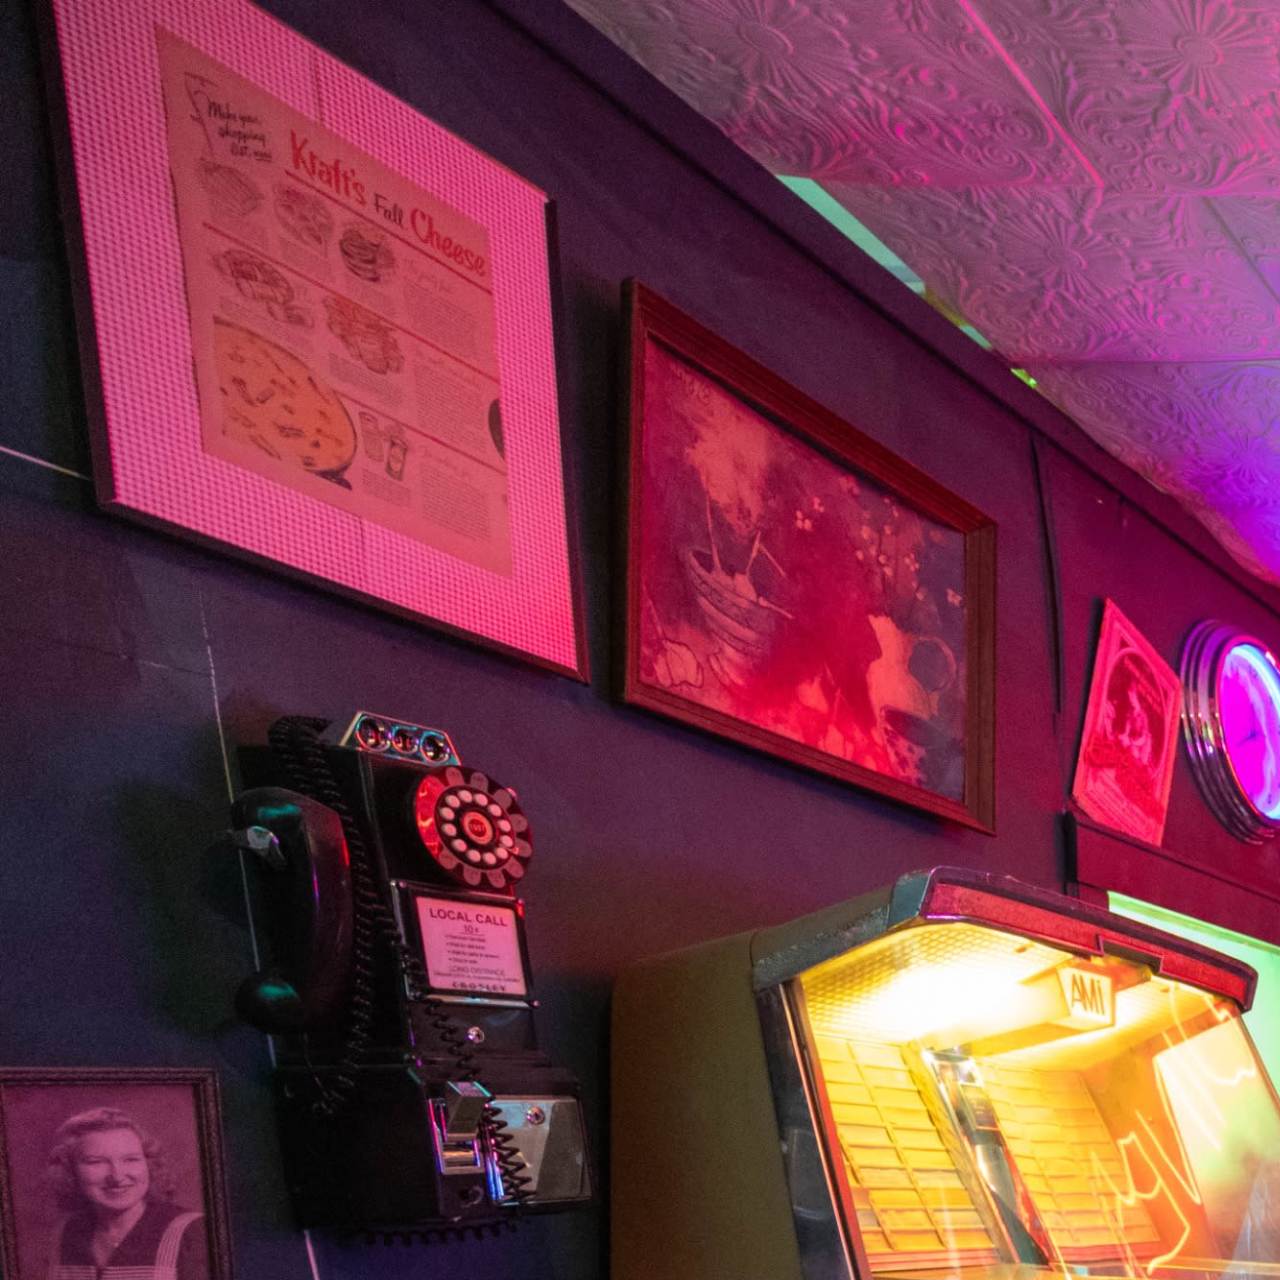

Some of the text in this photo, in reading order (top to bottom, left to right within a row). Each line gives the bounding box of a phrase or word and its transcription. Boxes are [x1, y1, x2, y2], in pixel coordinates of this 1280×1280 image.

[290, 129, 366, 206] Kraft's
[374, 193, 404, 230] Fall
[410, 208, 486, 277] Cheese
[429, 907, 508, 927] LOCAL CALL
